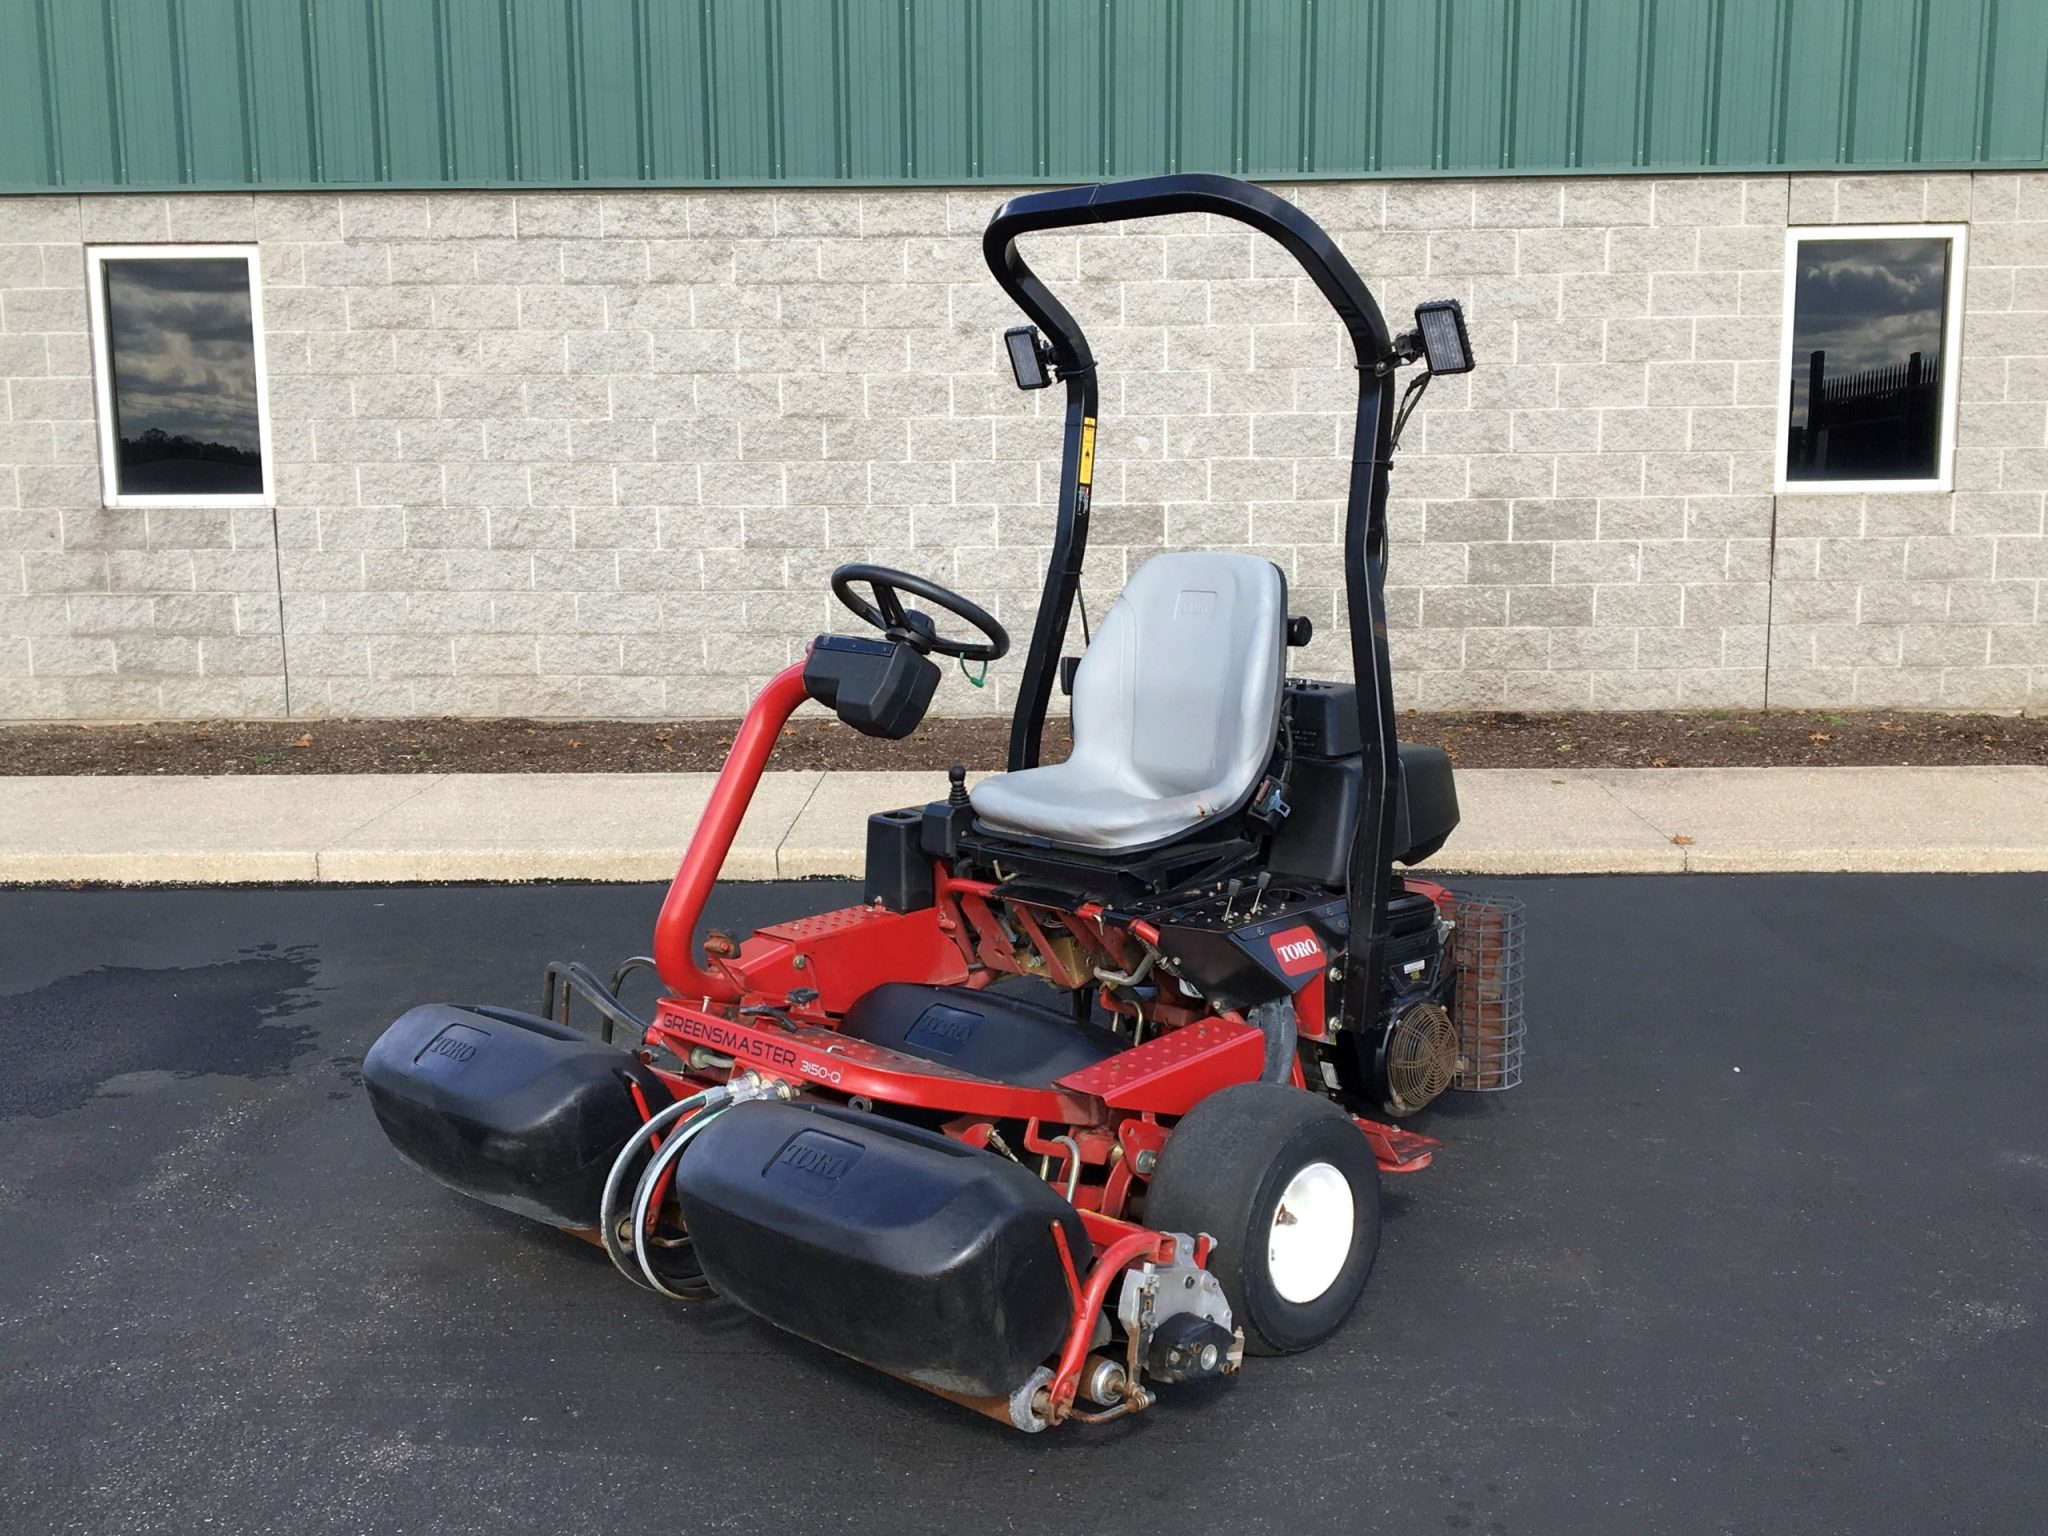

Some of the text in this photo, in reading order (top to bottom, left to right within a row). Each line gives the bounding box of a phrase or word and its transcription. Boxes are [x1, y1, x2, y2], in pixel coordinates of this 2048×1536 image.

[1276, 938, 1317, 963] TORO
[428, 1036, 478, 1062] TORO
[663, 1012, 841, 1084] GREENSMASTER 3150-Q
[781, 1144, 849, 1180] TORO
